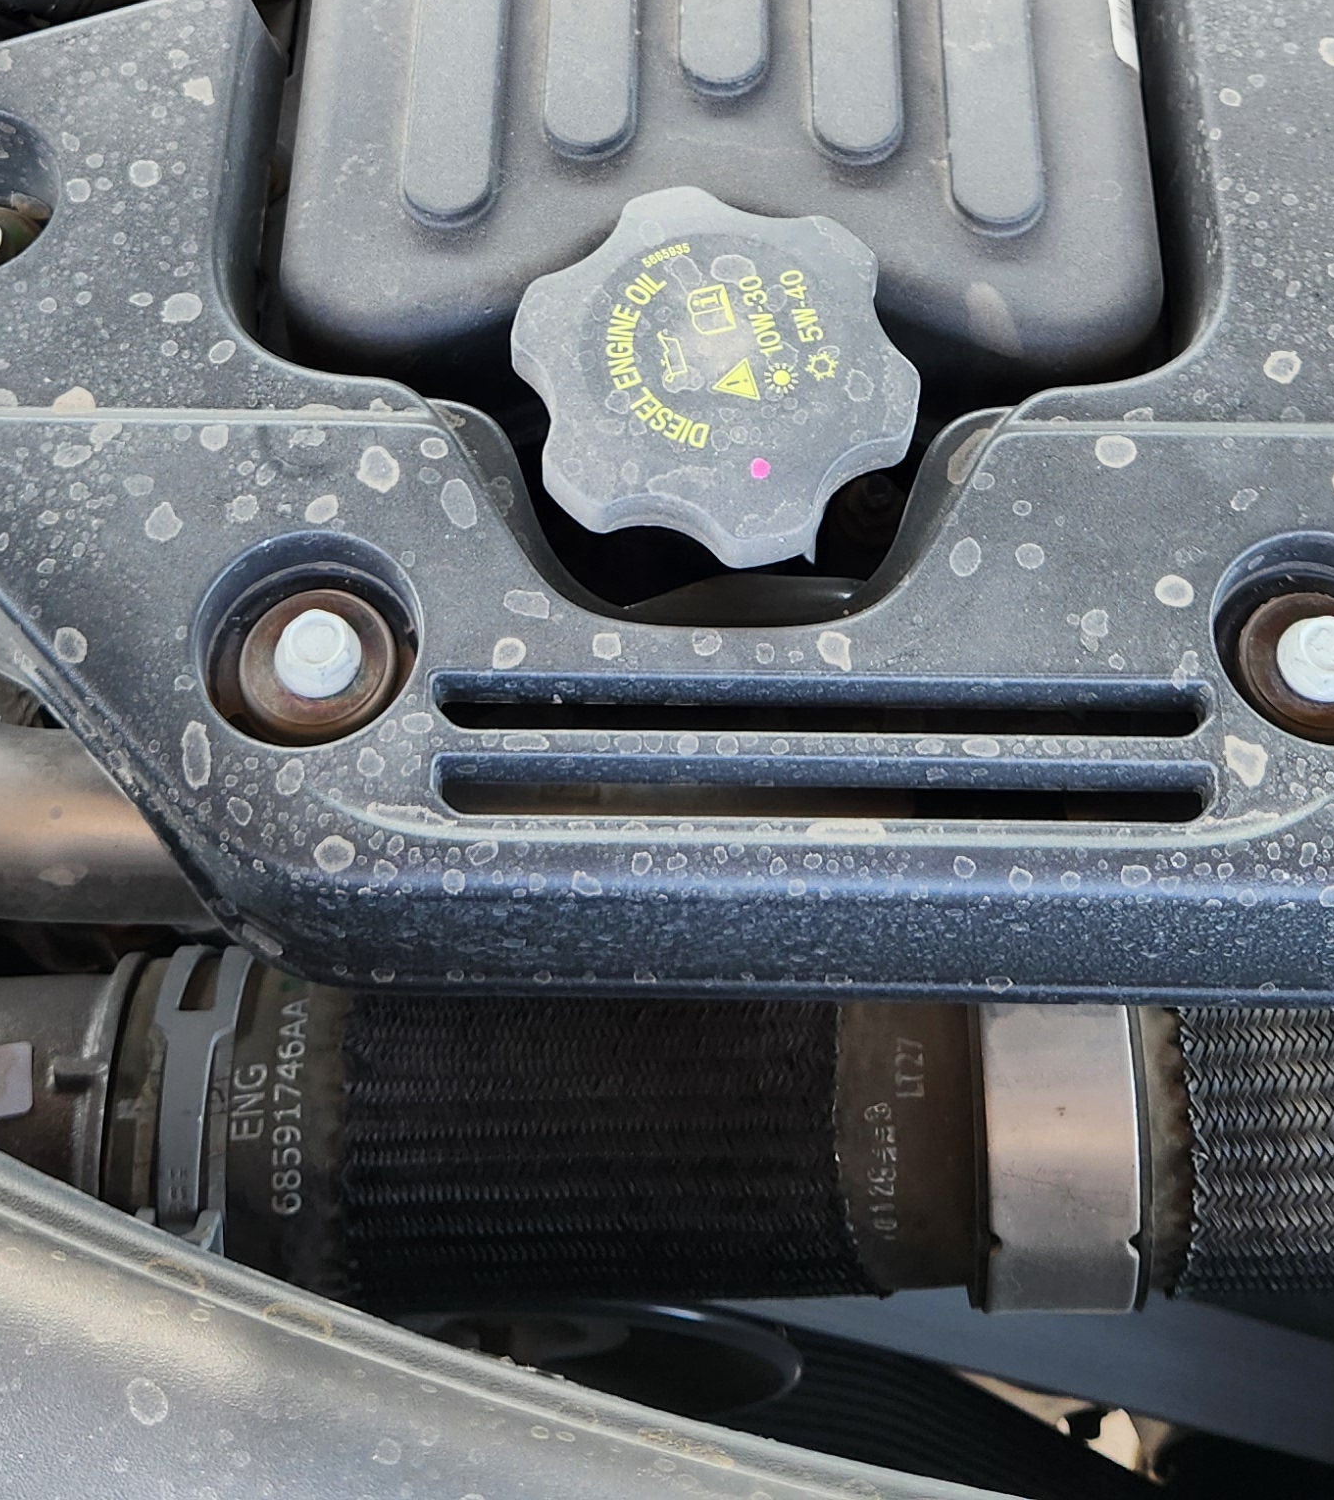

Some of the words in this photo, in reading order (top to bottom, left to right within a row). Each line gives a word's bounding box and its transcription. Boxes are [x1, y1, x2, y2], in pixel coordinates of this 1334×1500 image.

[624, 271, 668, 307] OIL
[738, 274, 784, 359] 10W-30
[779, 269, 825, 344] 5W-40
[605, 303, 642, 391] ENGINE
[629, 386, 710, 449] DIESEL
[230, 1062, 267, 1142] ENG
[271, 997, 311, 1216] 68591746AA
